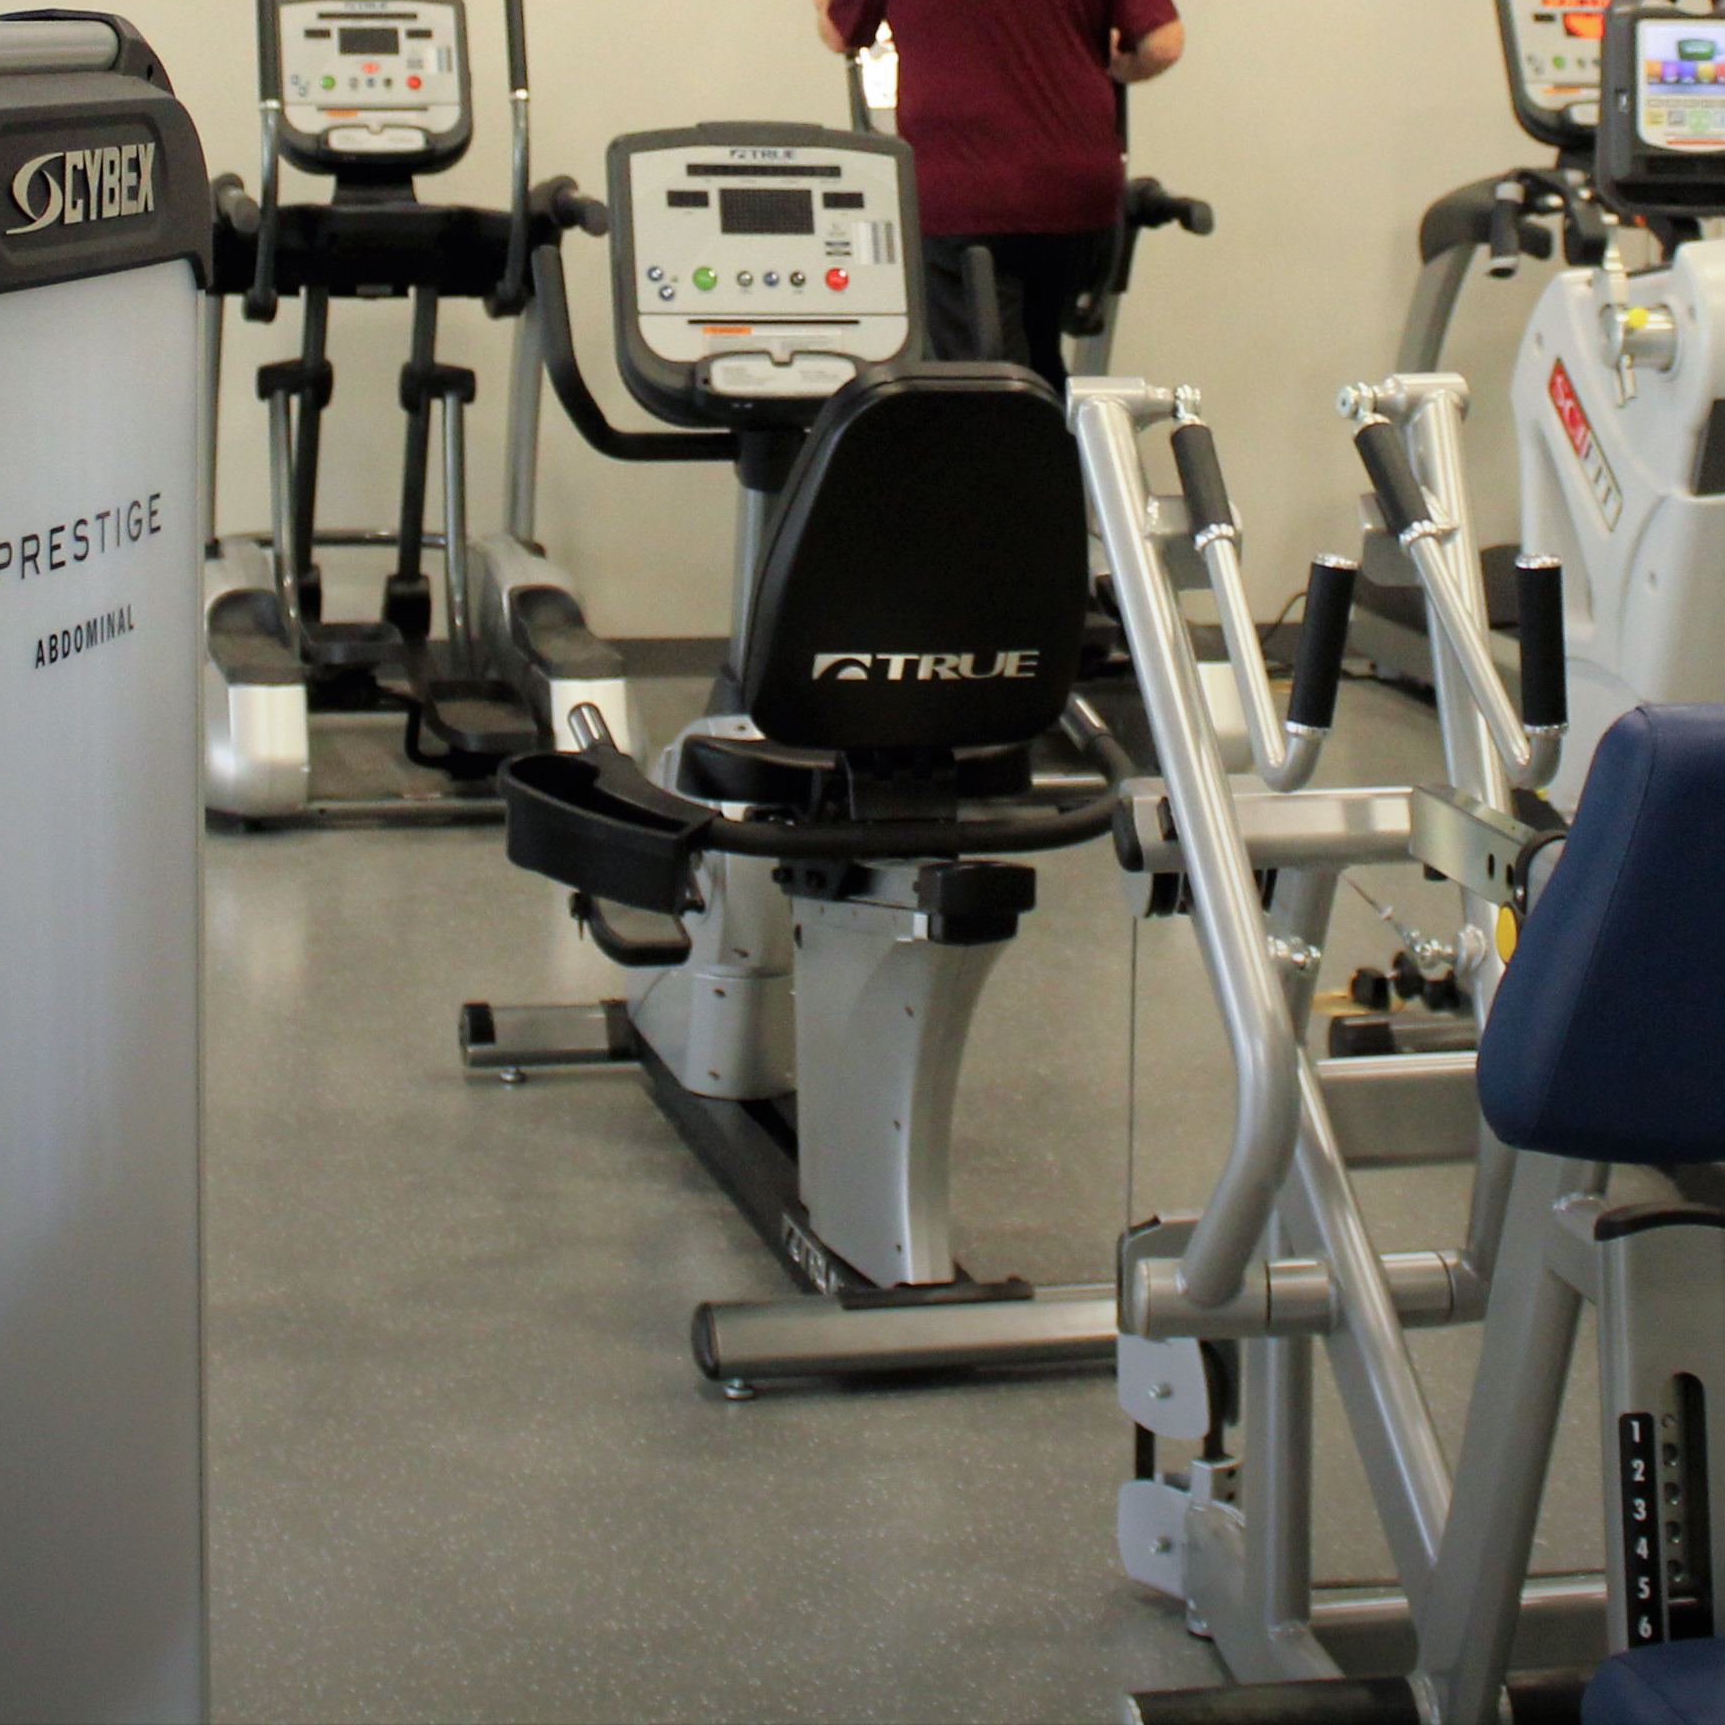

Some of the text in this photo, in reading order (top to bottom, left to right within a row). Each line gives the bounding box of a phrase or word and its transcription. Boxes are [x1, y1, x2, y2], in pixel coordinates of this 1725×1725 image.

[63, 142, 156, 225] CYBEX
[35, 603, 135, 670] ABDOMINAL
[875, 650, 1040, 680] TRUE
[1630, 1421, 1641, 1443] 1
[1630, 1459, 1645, 1482] 2
[1632, 1498, 1647, 1521] 3
[1635, 1537, 1649, 1559] 4
[1637, 1577, 1651, 1600] 5
[1637, 1616, 1652, 1639] 6
